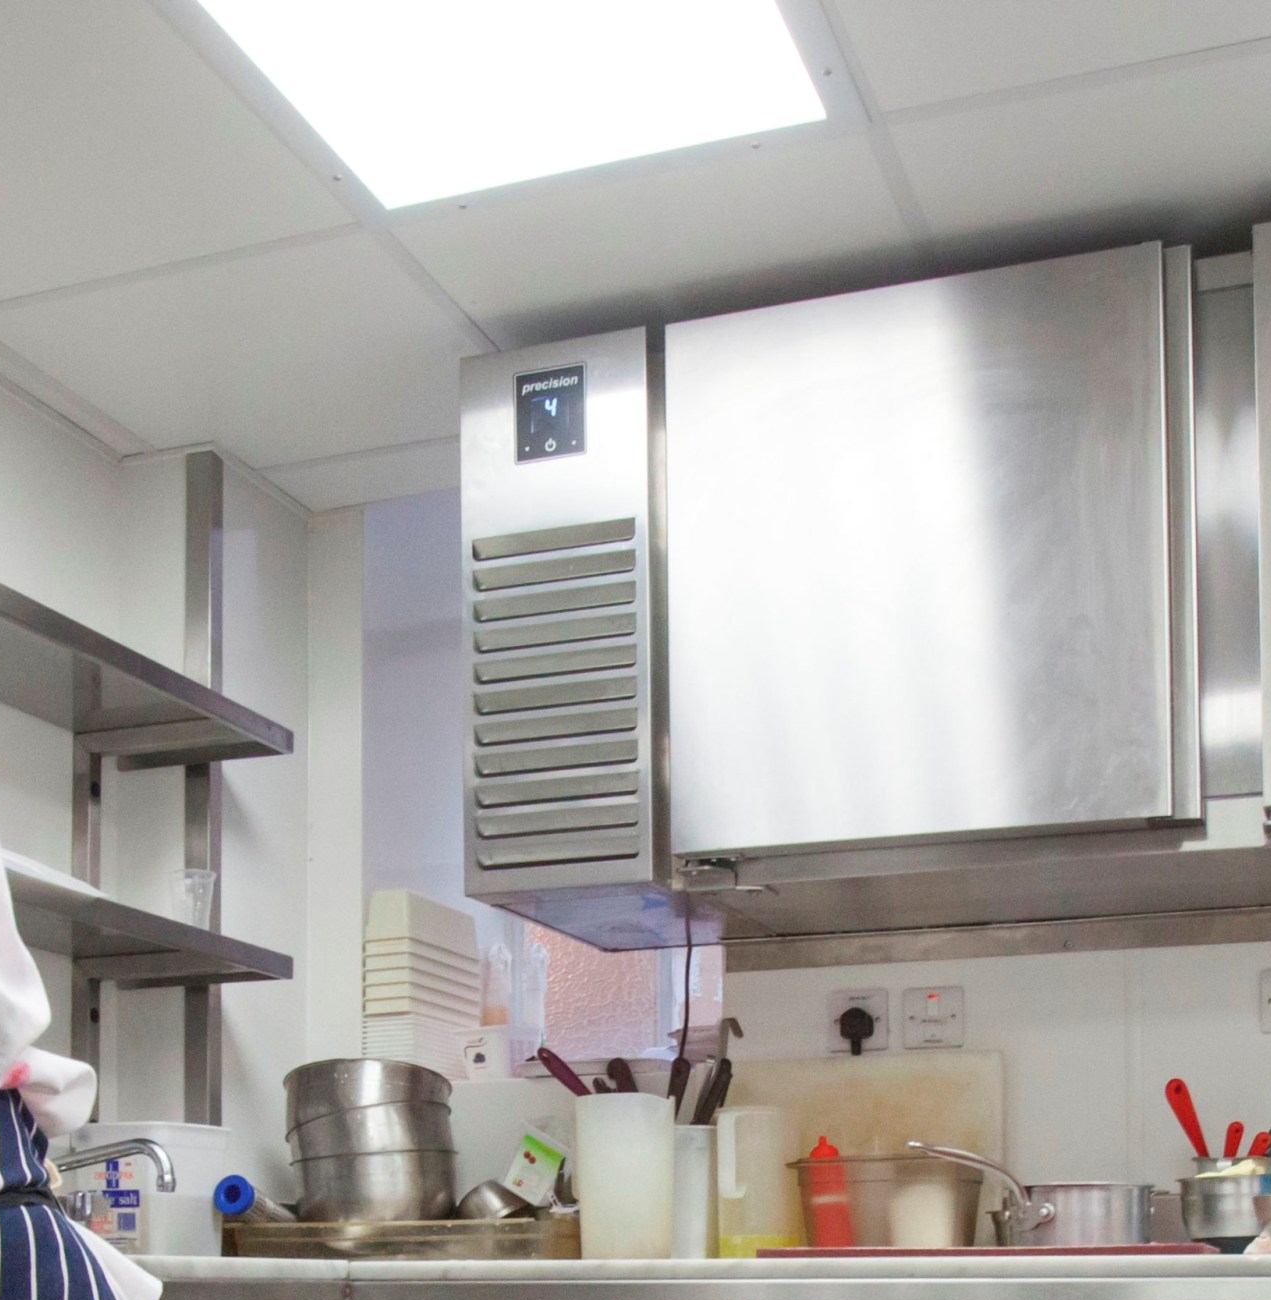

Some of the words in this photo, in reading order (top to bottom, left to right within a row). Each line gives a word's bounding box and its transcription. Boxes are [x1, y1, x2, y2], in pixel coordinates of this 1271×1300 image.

[521, 375, 579, 396] precision
[544, 397, 558, 417] 4
[119, 1192, 138, 1206] salt
